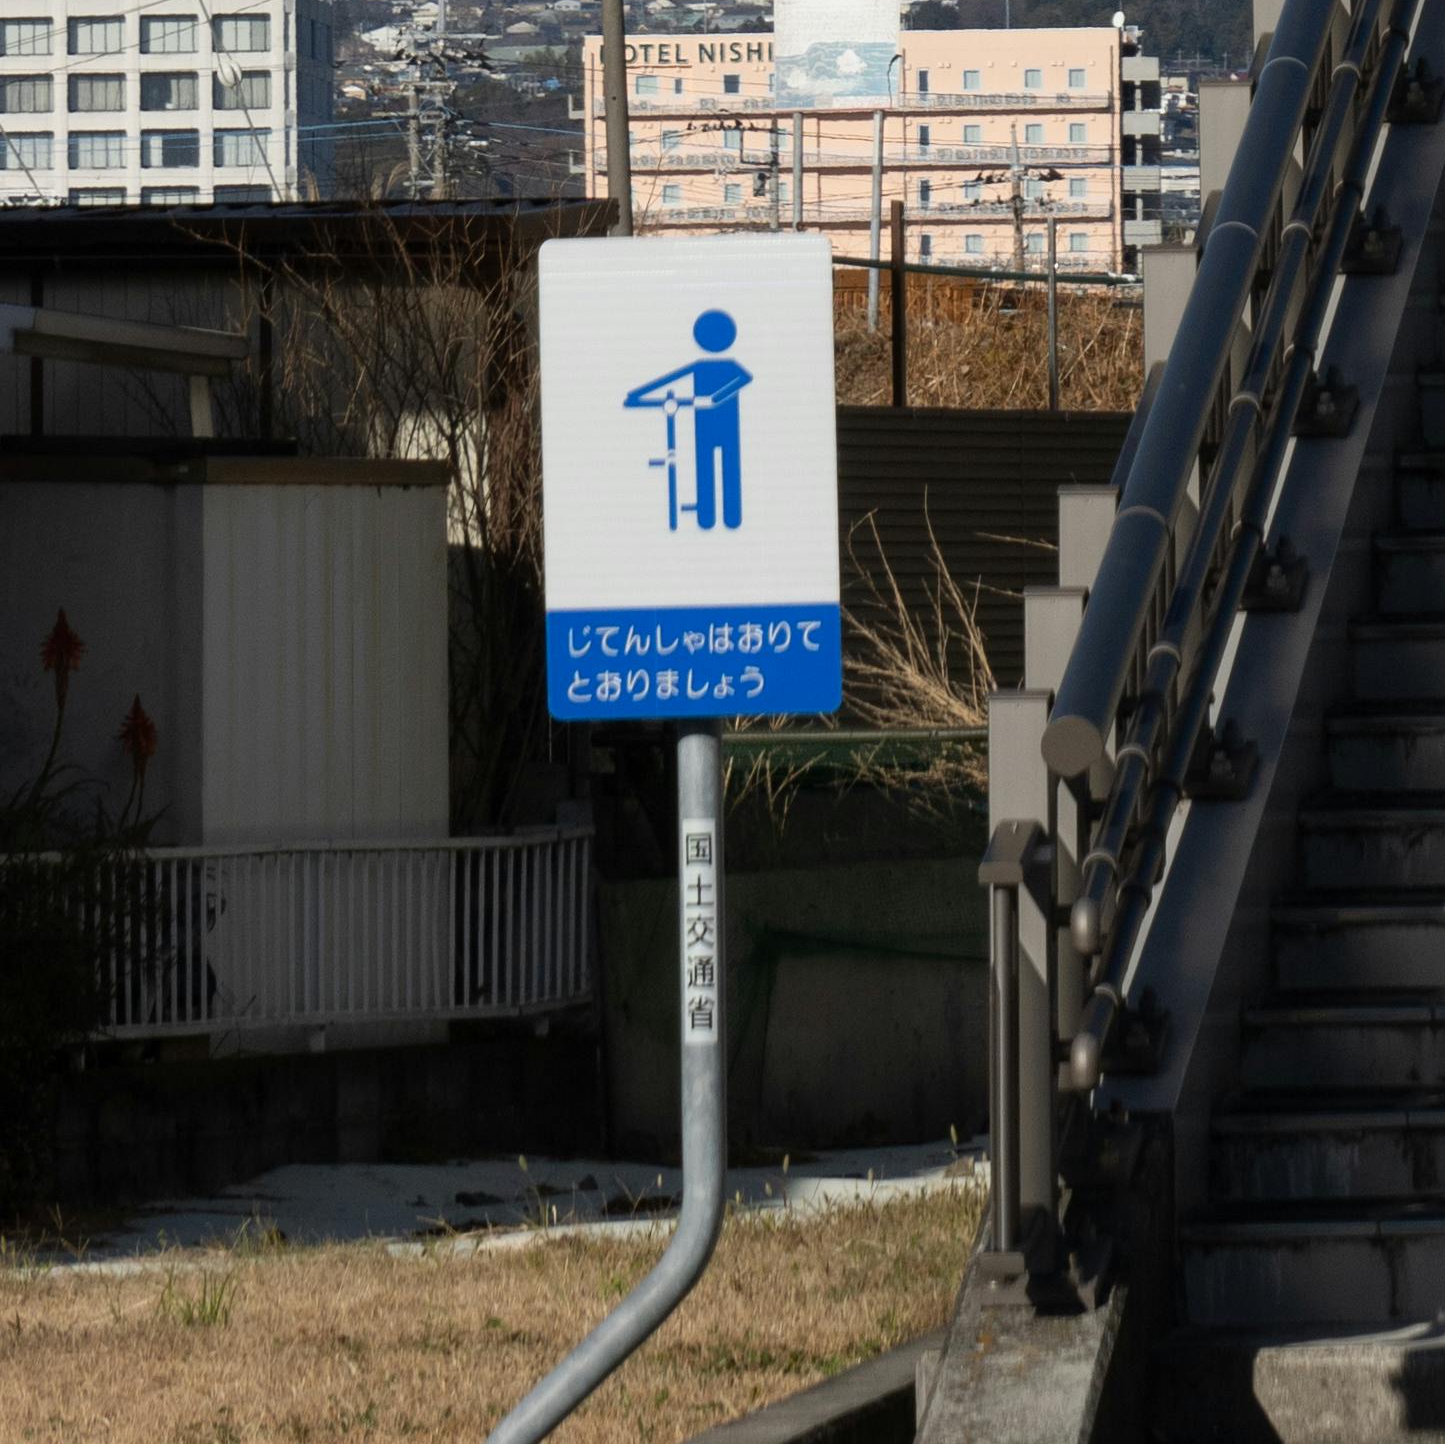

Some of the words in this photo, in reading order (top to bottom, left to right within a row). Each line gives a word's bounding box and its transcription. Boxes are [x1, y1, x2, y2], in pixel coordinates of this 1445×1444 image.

[600, 43, 690, 64] OTEL
[567, 619, 822, 659] じてんしゃはおりて
[566, 665, 766, 703] とおりましょう
[685, 832, 716, 1031] 国土交通省
